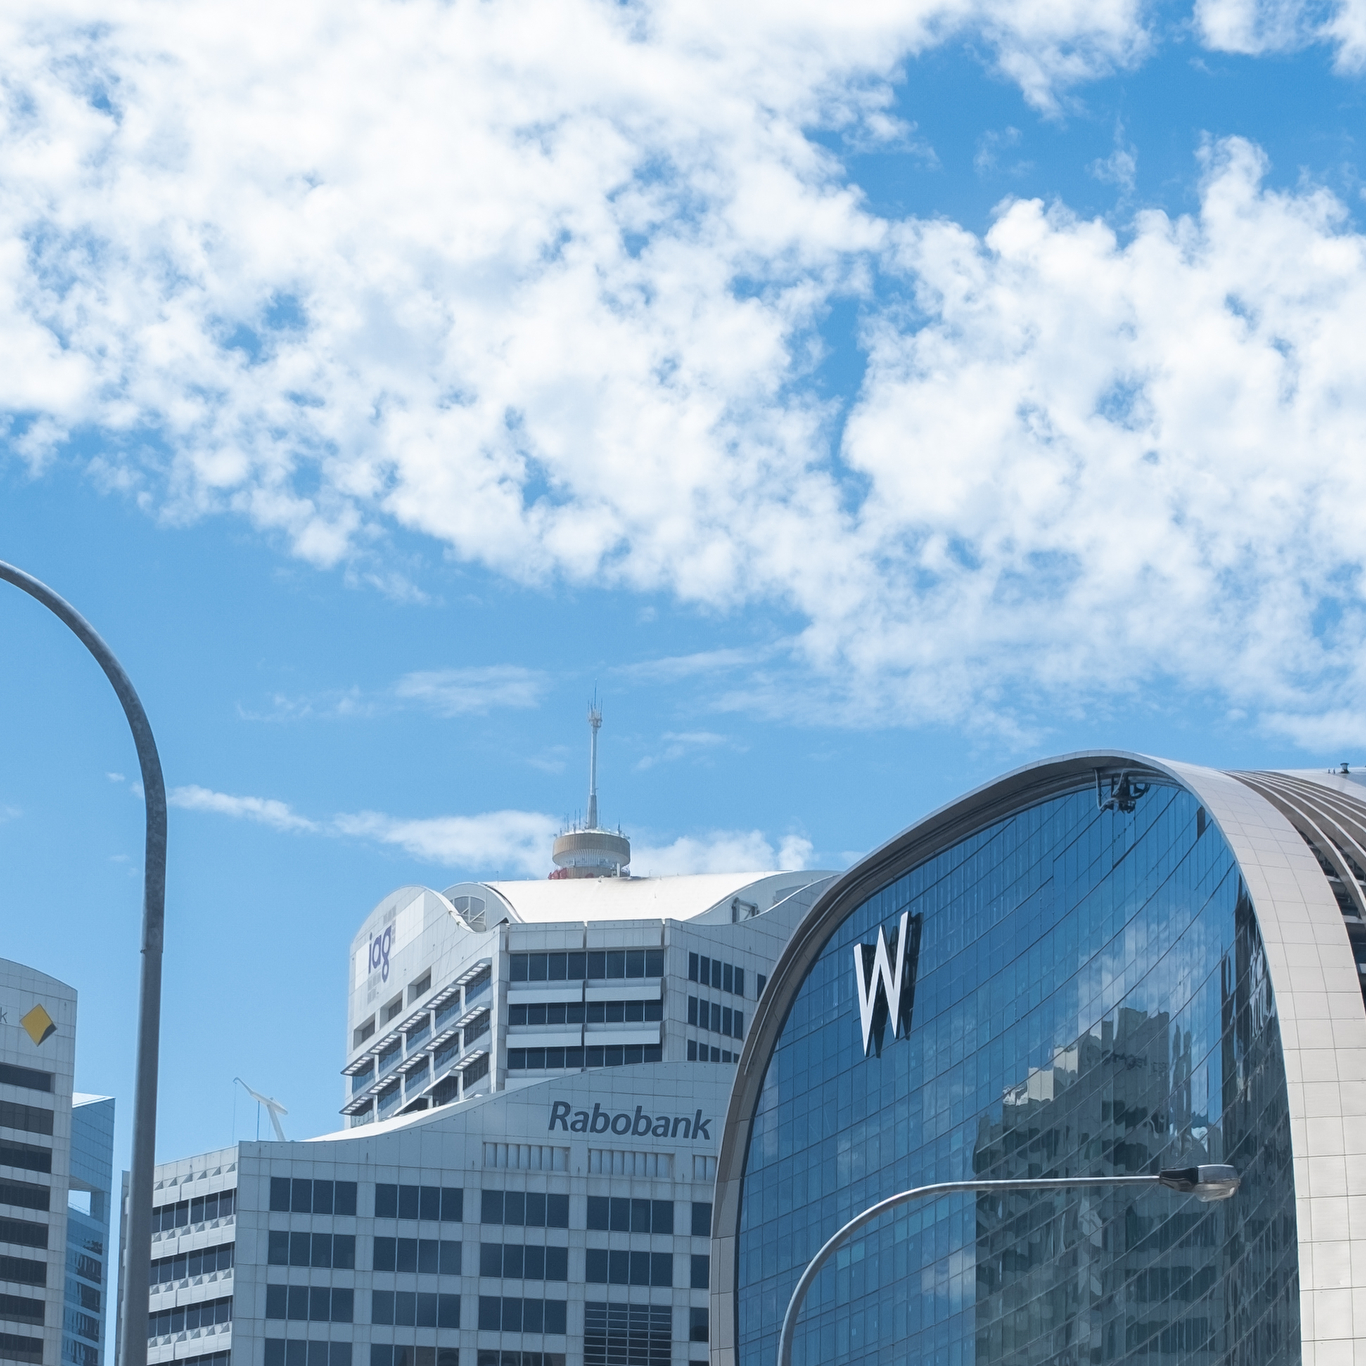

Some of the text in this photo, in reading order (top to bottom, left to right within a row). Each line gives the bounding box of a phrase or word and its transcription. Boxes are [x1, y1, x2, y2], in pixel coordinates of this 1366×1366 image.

[368, 925, 392, 983] iag
[853, 910, 909, 1057] W
[548, 1100, 712, 1141] Rabobank
